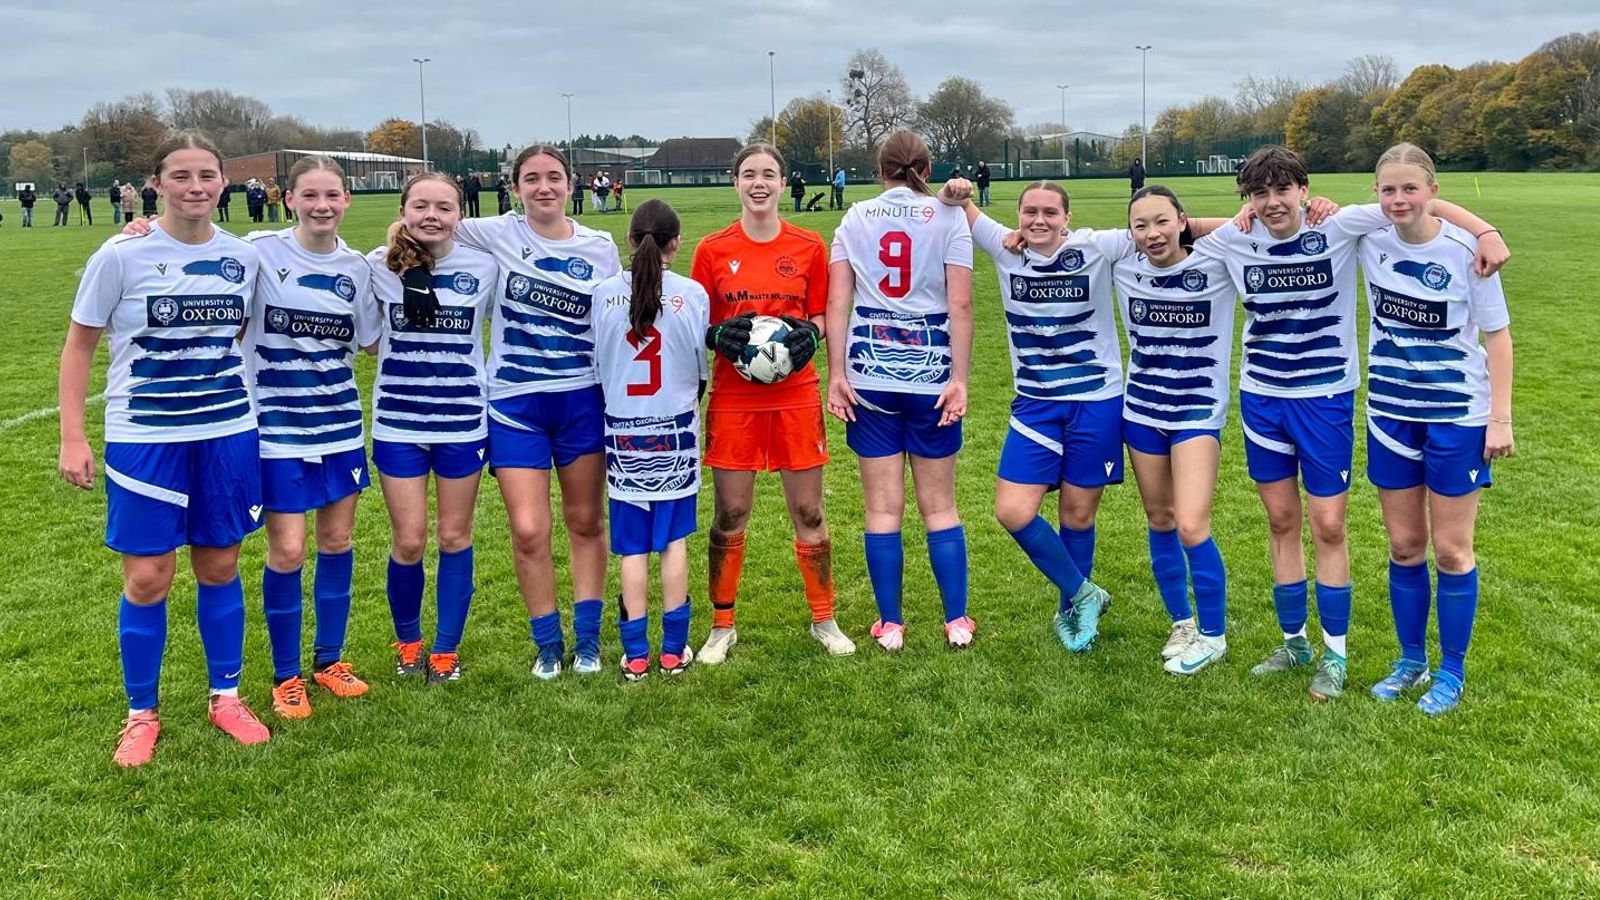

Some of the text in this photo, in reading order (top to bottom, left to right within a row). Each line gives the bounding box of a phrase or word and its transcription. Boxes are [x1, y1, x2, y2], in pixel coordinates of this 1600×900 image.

[878, 230, 912, 299] 9
[1267, 265, 1315, 275] UNIVERSITY OF
[1029, 279, 1064, 287] UNIVERSITY
[1267, 274, 1328, 289] OXFORD
[534, 283, 580, 302] UNIVERSITY OF
[1029, 287, 1084, 299] OXFORD
[529, 291, 586, 316] OXFORD
[1384, 293, 1418, 308] UNIVERSITY
[182, 308, 242, 321] OXFORD
[1150, 304, 1185, 312] UNIVERSITY
[1382, 303, 1440, 324] OXFORD
[293, 314, 334, 324] UNIVERSITY
[428, 317, 470, 330] FORD
[1150, 312, 1205, 324] OXFORD
[291, 321, 350, 337] OXFORD
[625, 325, 662, 396] 3
